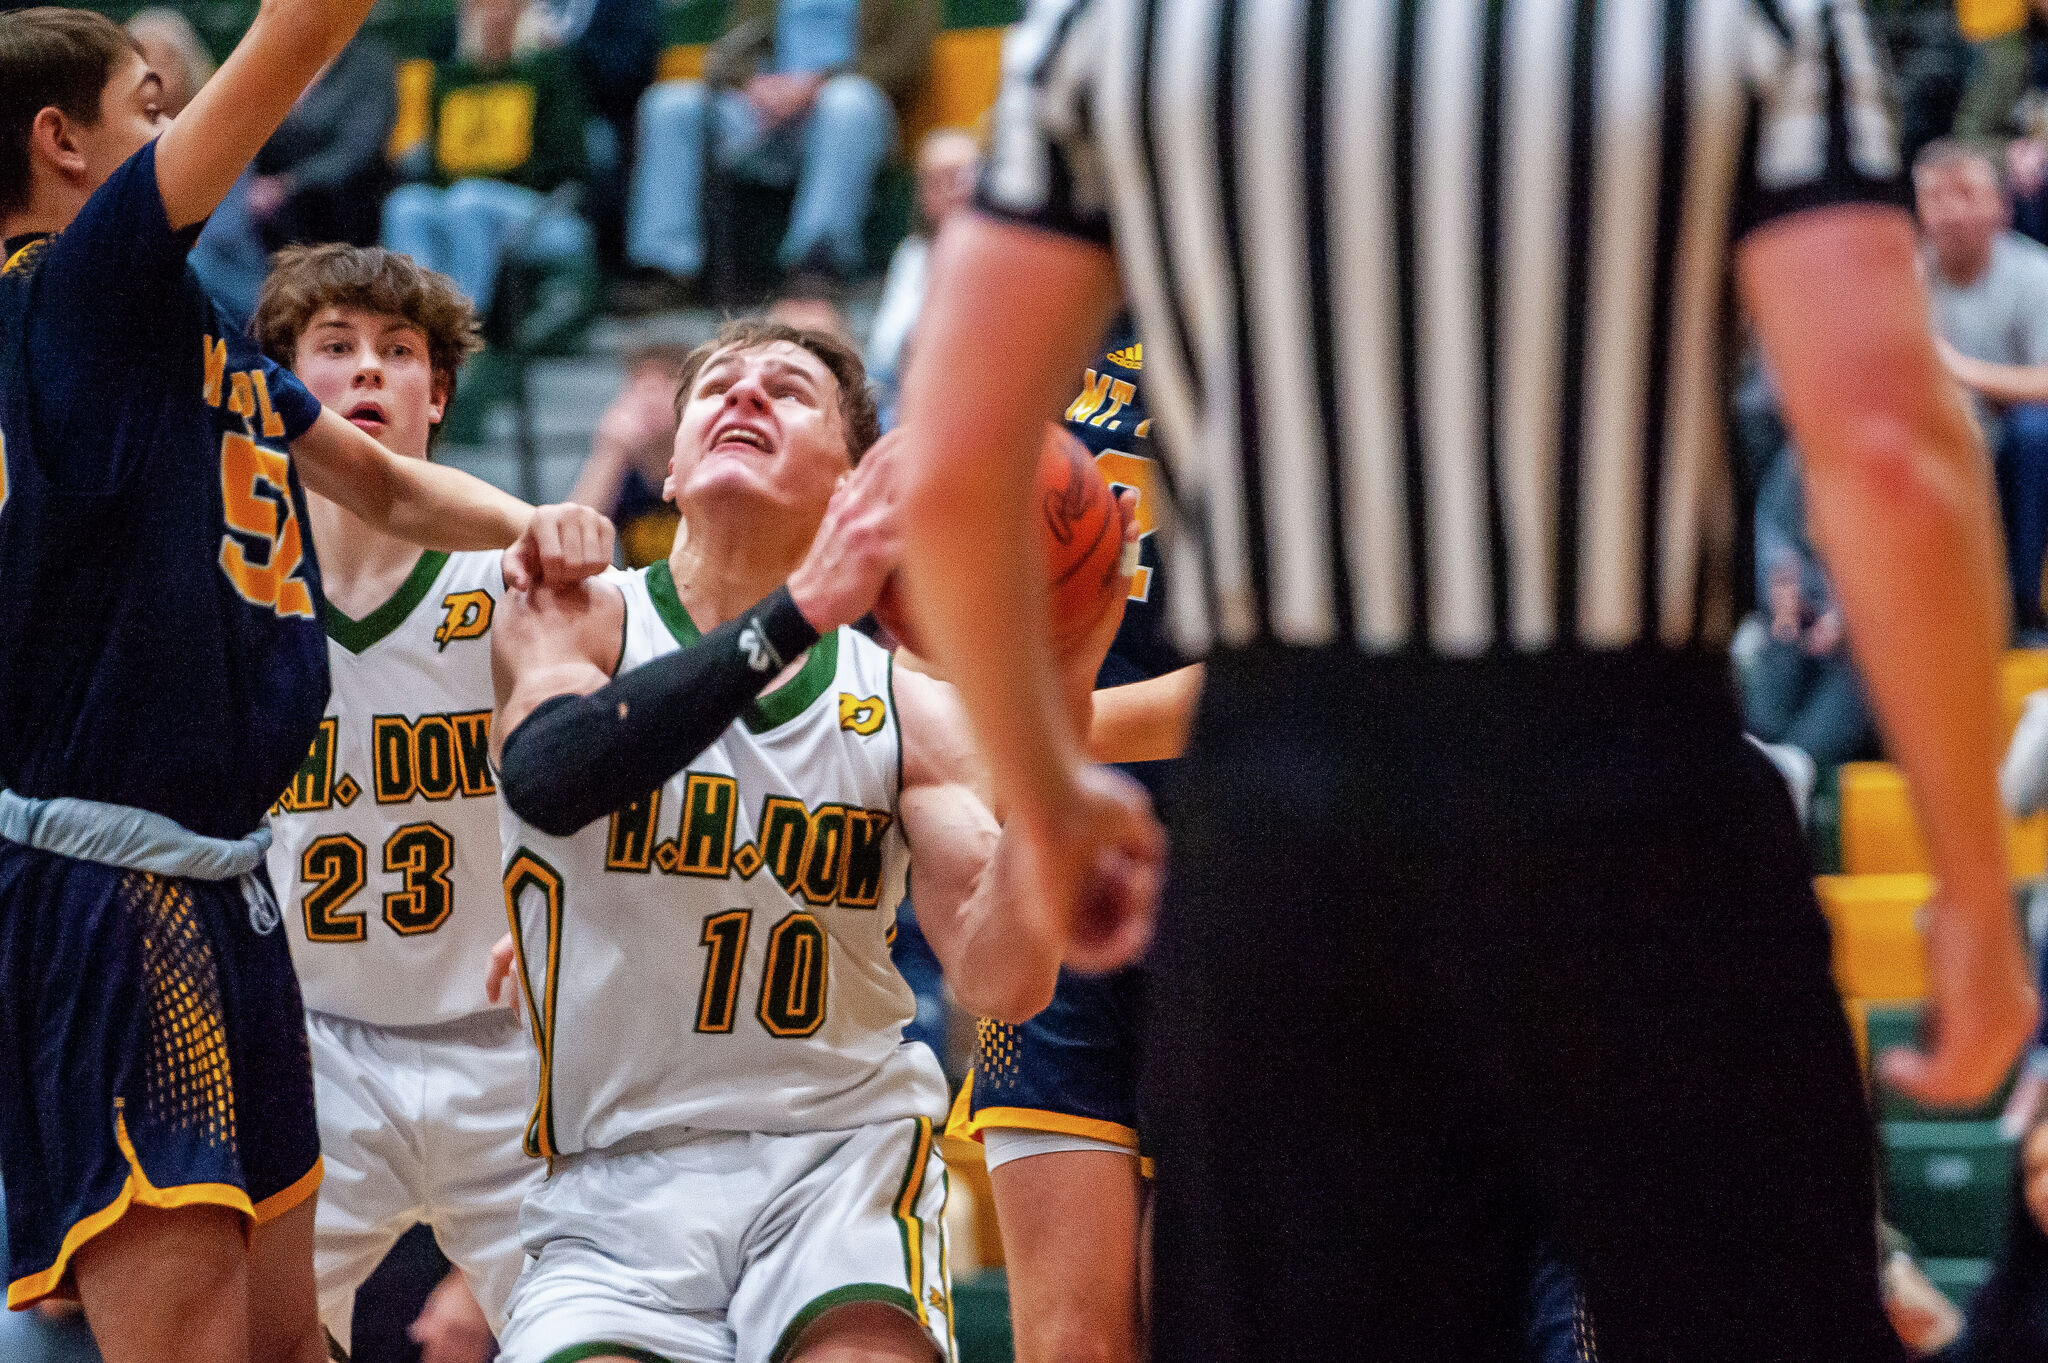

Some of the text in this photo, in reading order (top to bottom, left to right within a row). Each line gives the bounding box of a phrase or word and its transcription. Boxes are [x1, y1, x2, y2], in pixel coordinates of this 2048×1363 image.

[372, 709, 497, 806] DOW
[301, 821, 454, 942] 23
[694, 908, 828, 1038] 10
